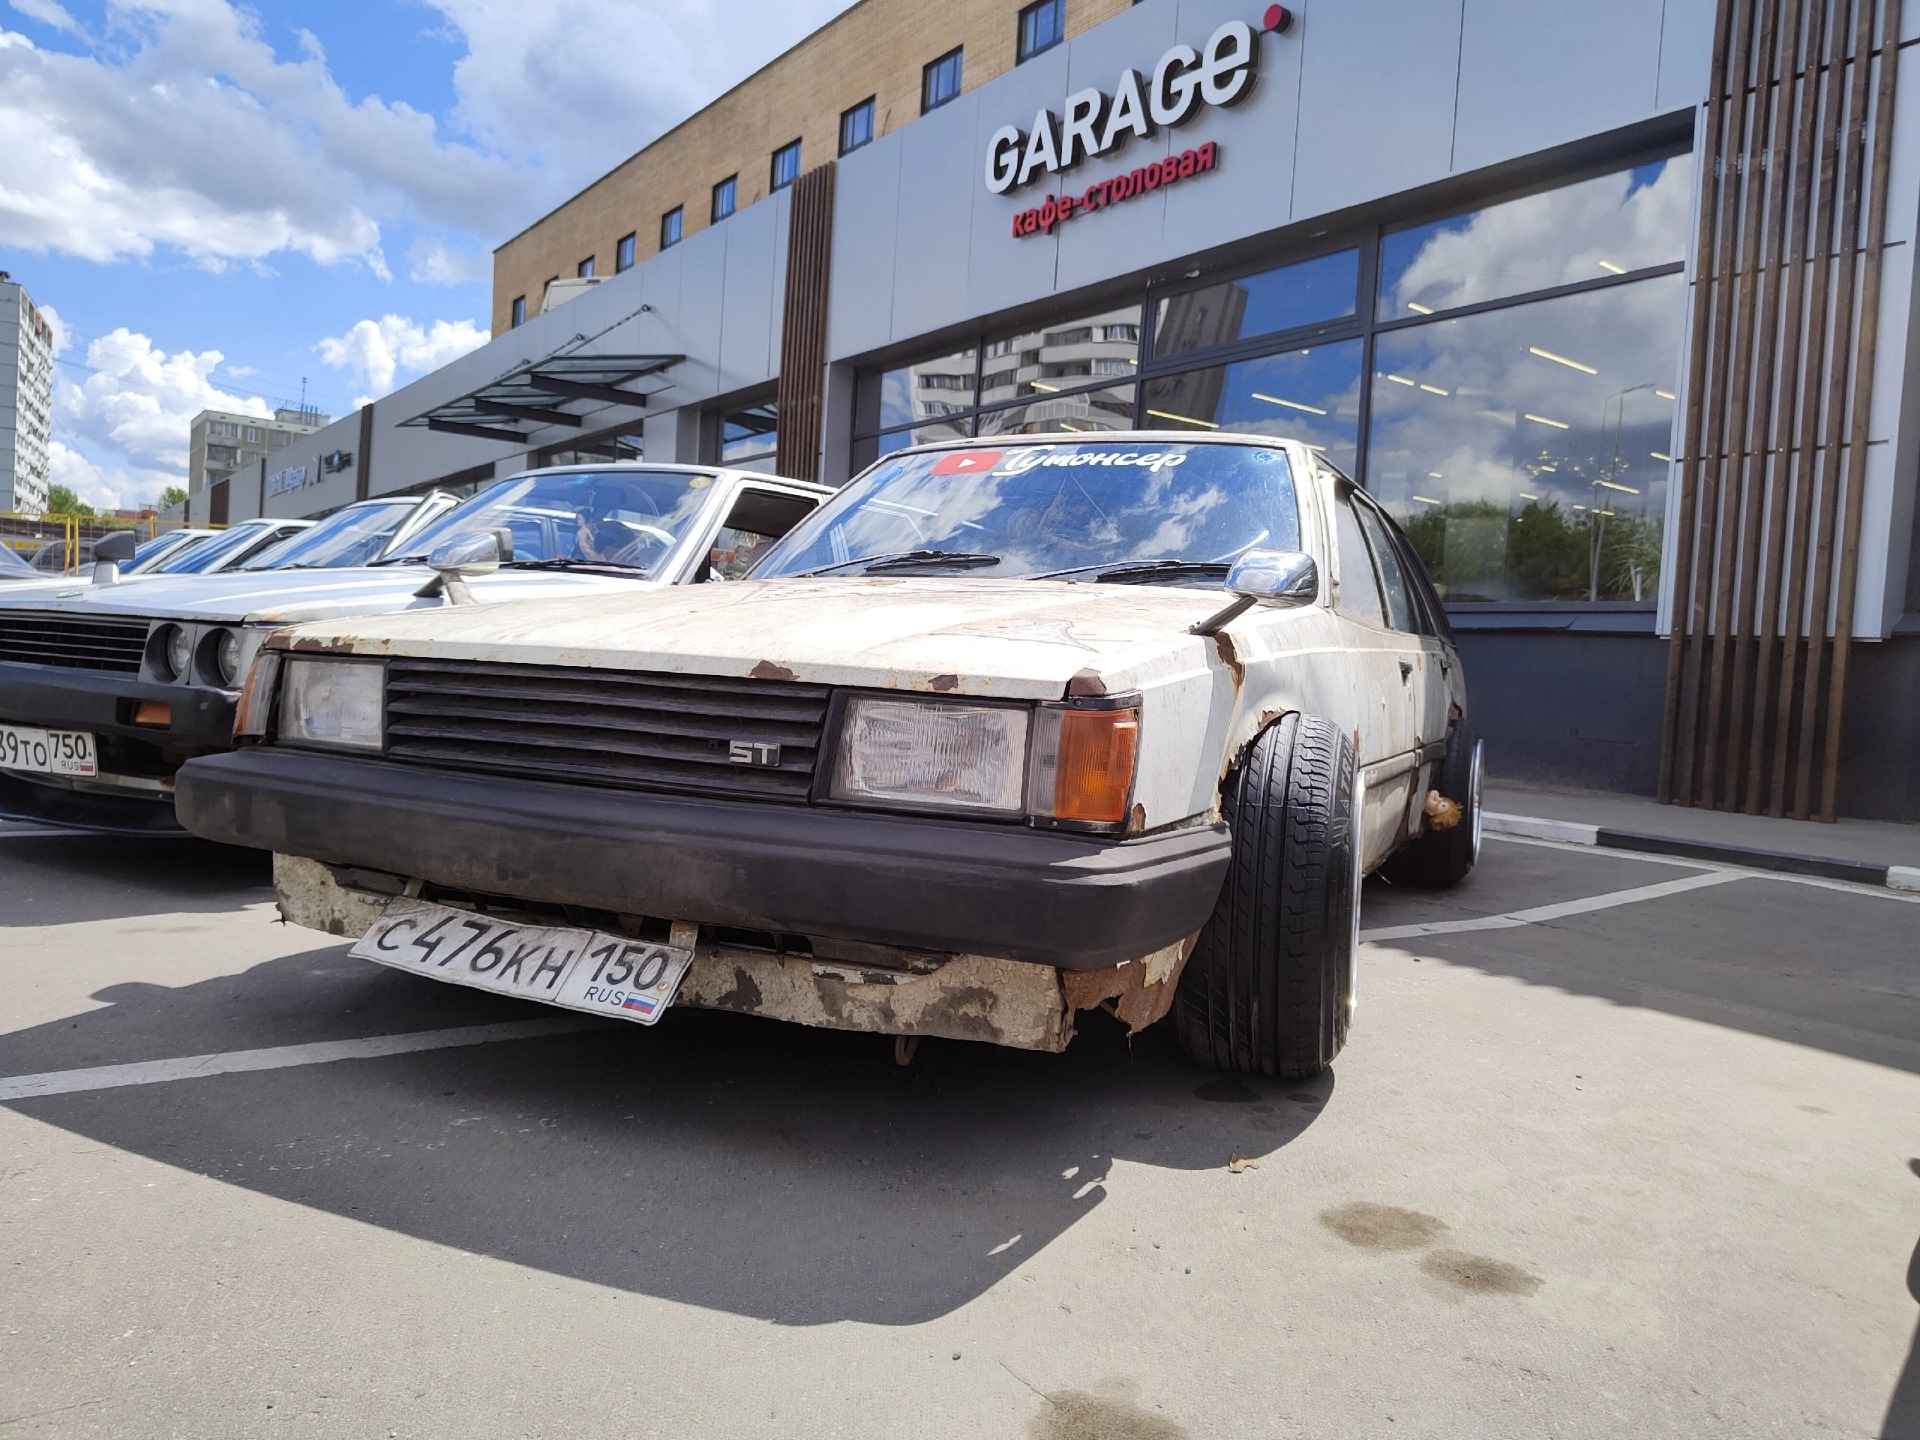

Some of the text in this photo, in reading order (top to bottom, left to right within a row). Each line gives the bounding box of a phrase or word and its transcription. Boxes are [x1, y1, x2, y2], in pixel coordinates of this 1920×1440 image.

[1012, 141, 1217, 238] кафе-столовая
[49, 733, 87, 760] 750
[729, 740, 779, 765] ST
[61, 760, 80, 771] RUS
[590, 943, 669, 991] 150
[583, 986, 625, 1006] RUS
